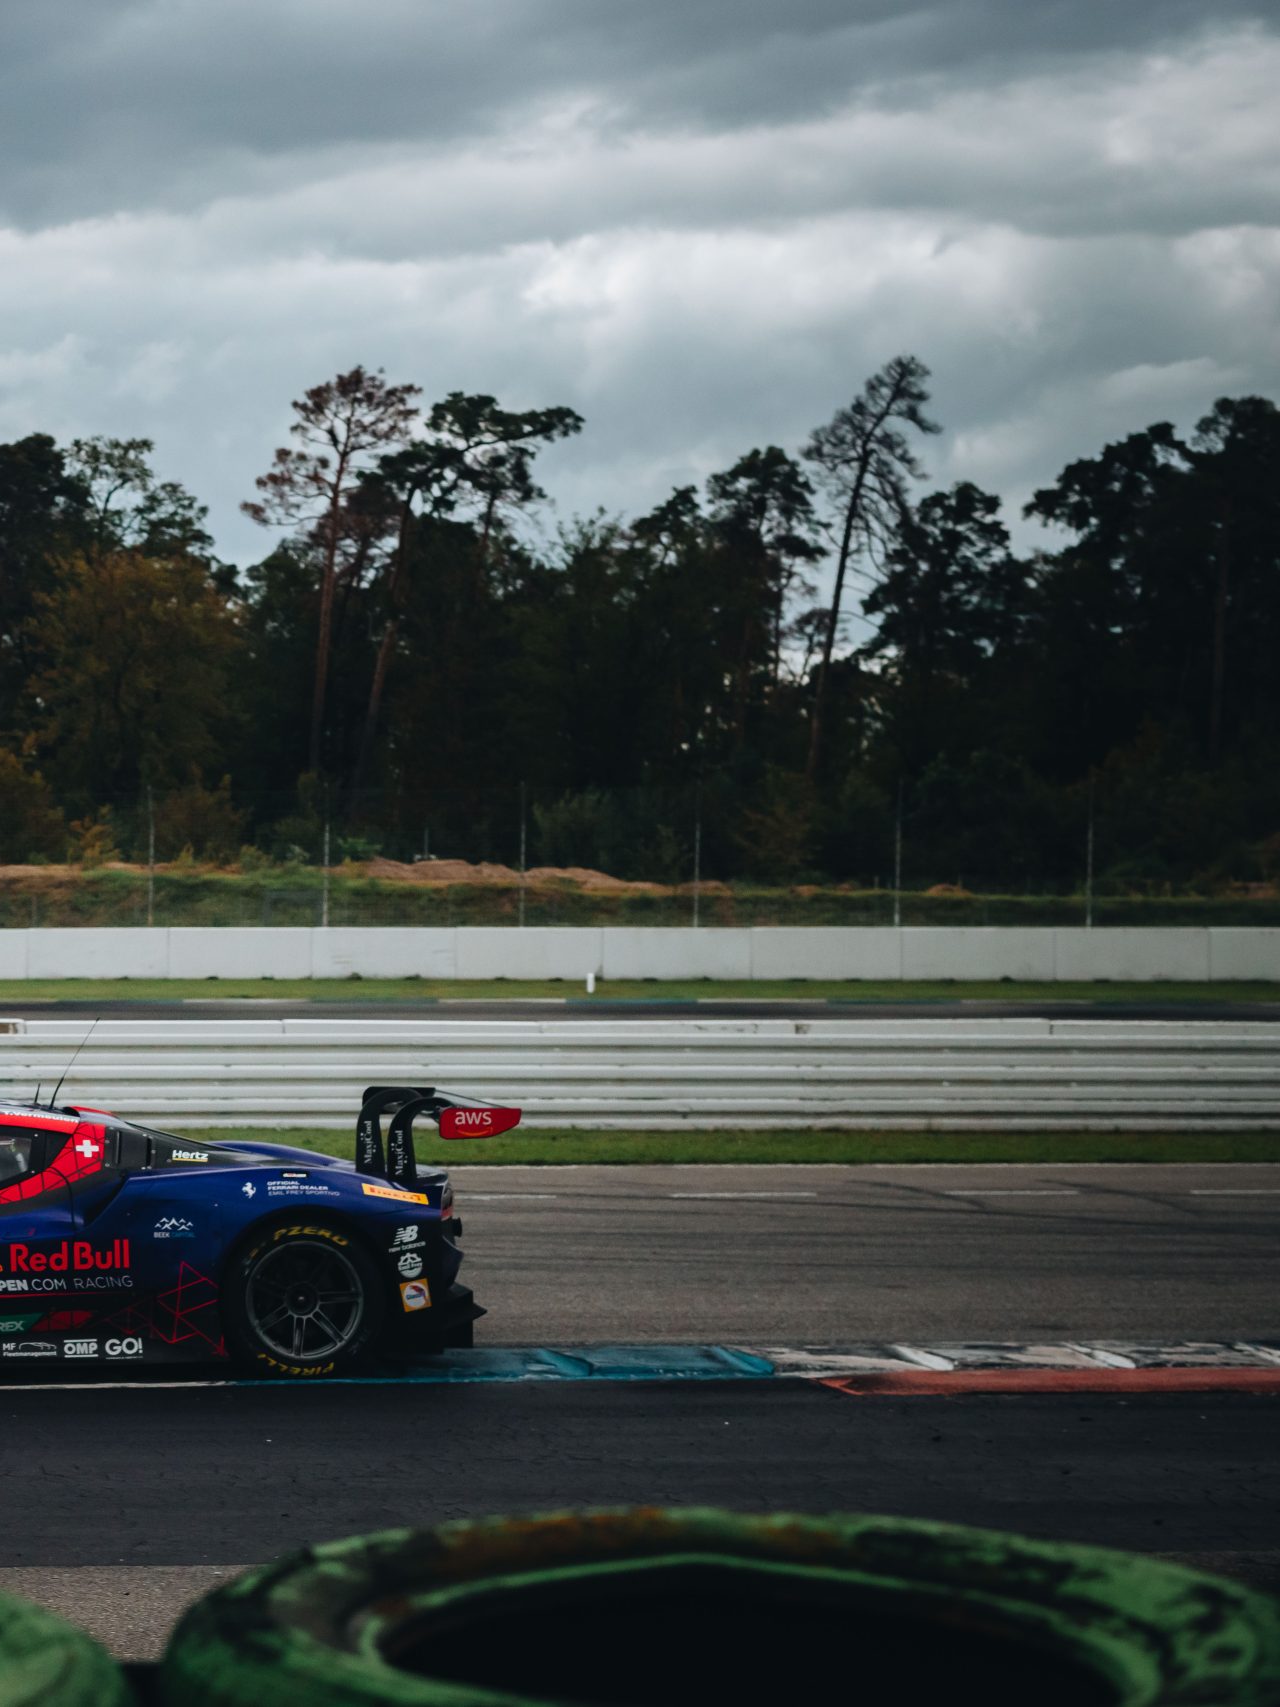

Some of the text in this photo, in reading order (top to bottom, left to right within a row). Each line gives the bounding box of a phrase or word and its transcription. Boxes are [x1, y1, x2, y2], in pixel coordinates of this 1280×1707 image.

[455, 1111, 492, 1125] aws
[364, 1120, 373, 1164] MaxiCool
[172, 1150, 209, 1160] Hertz
[395, 1130, 404, 1176] MaxiCool
[153, 1231, 170, 1239] BEEK
[10, 1238, 130, 1273] Red Bull
[73, 1275, 134, 1290] RACING
[2, 1342, 17, 1351] MF
[63, 1342, 98, 1355] OMP
[105, 1337, 144, 1356] GO!
